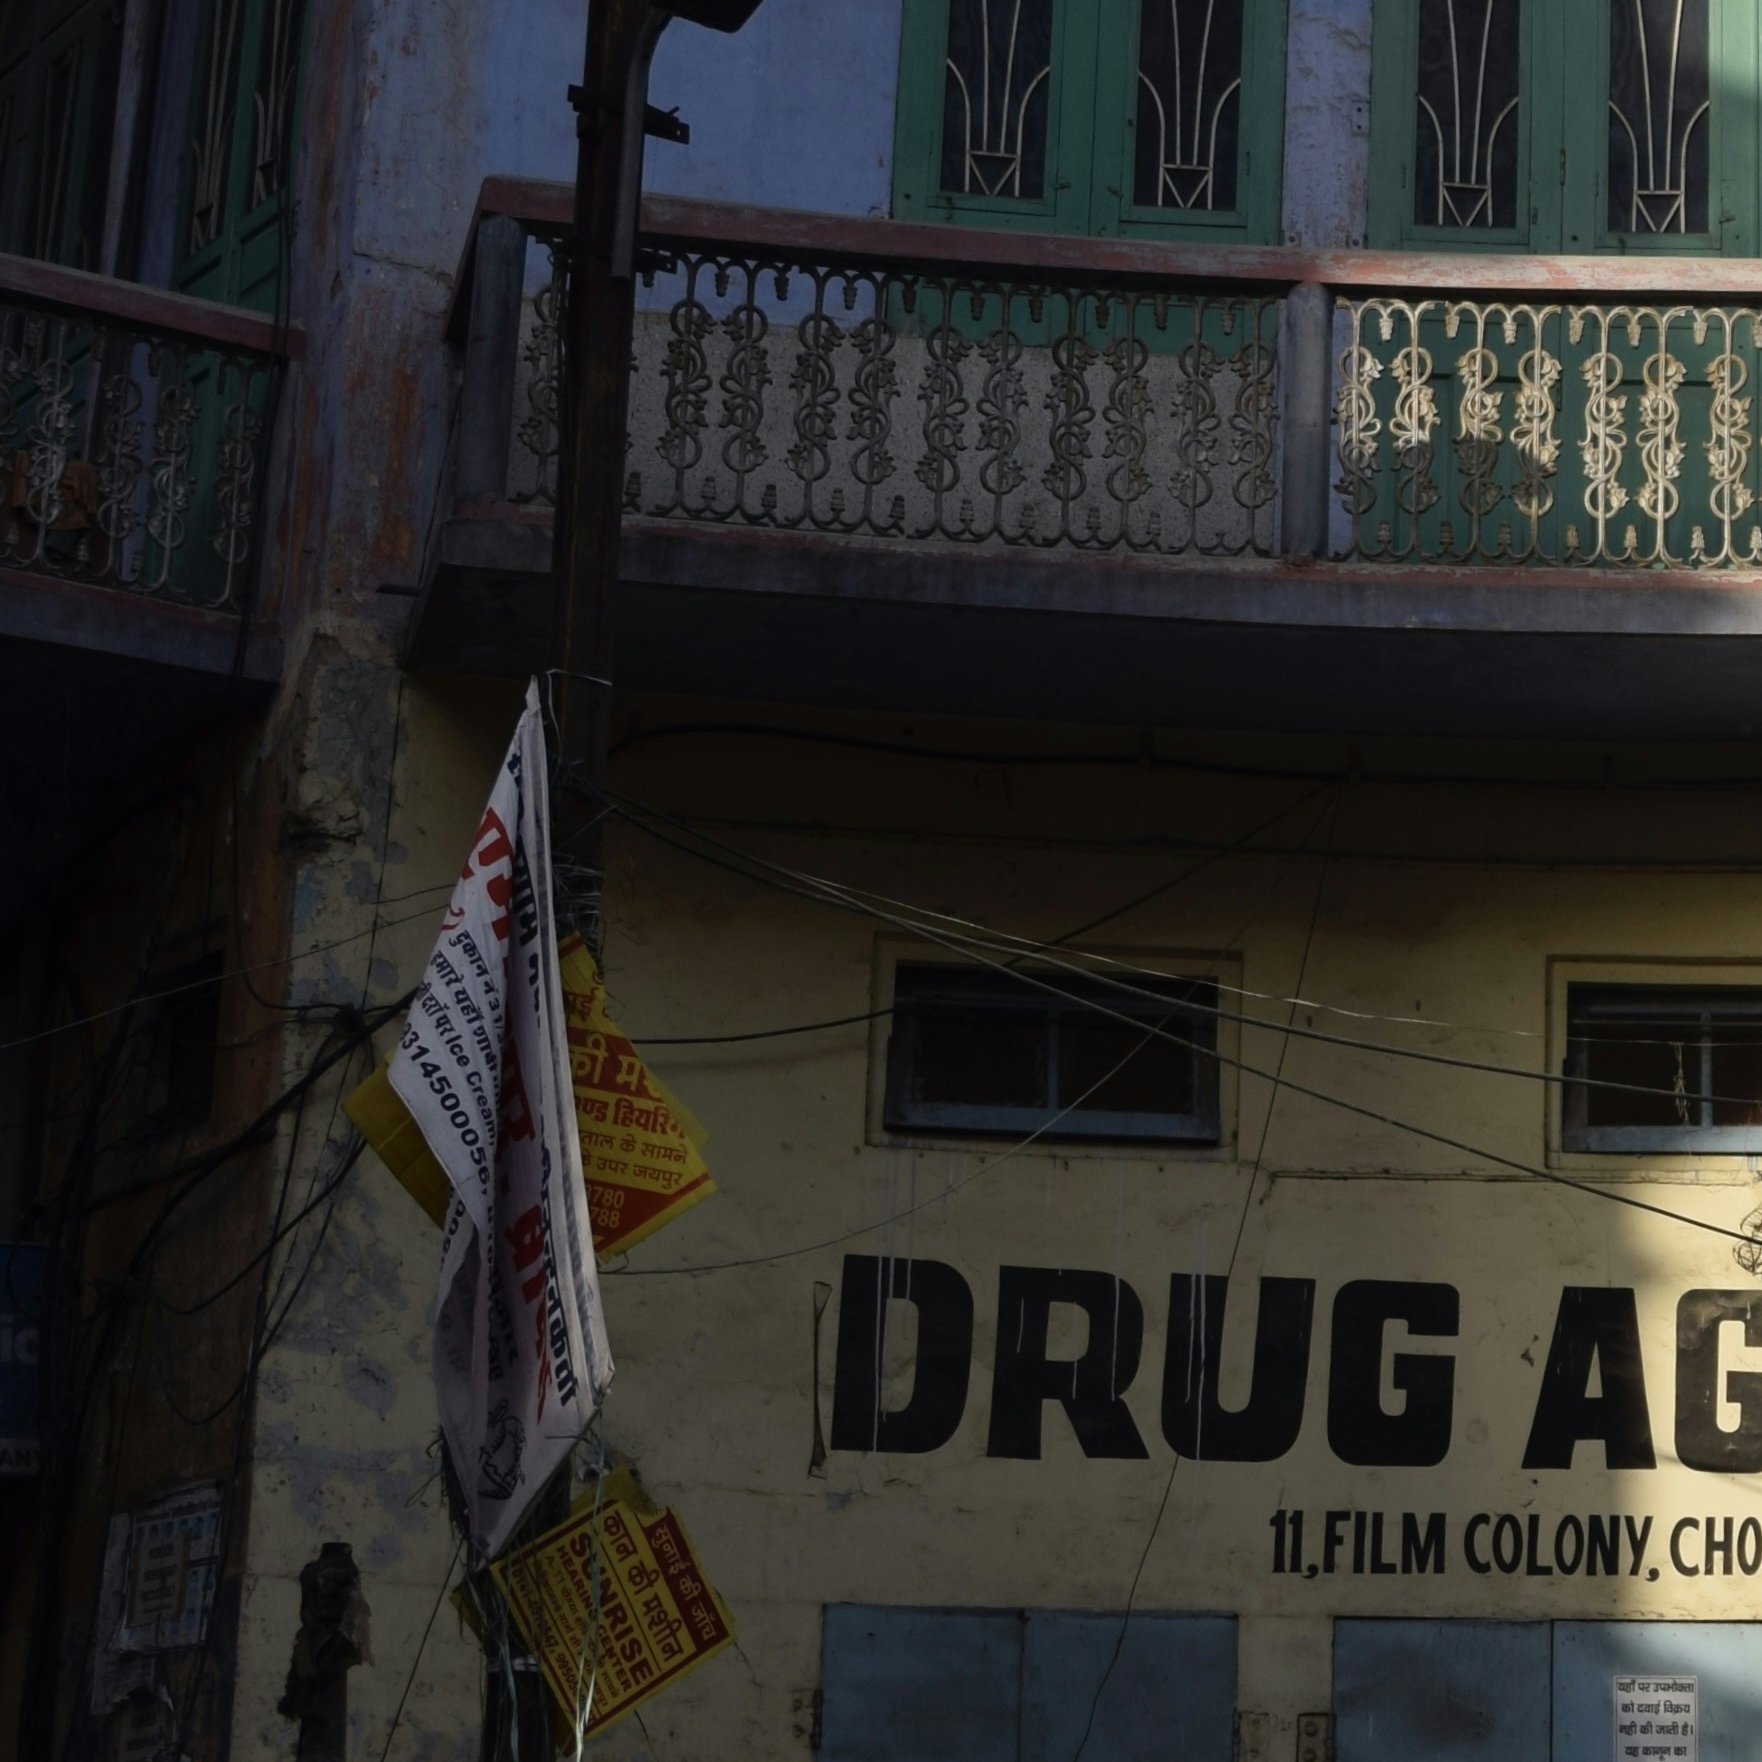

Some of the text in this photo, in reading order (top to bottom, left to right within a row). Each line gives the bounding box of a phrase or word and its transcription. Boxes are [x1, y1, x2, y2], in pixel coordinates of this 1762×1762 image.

[445, 1032, 470, 1072] Ice
[620, 1133, 688, 1165] के सामने
[595, 1156, 683, 1189] उपर जयपुर
[830, 1253, 1460, 1467] DRUG
[652, 1523, 692, 1575] सुनाई
[679, 1578, 702, 1602] की
[604, 1510, 684, 1661] कान की मशीन
[570, 1533, 654, 1686] SUNRISE
[597, 1624, 633, 1692] CENTER
[1638, 1683, 1650, 1693] पर
[1622, 1701, 1634, 1714] को
[1637, 1701, 1661, 1714] दवाई
[1640, 1721, 1652, 1735] की
[1656, 1722, 1679, 1735] जाती
[1626, 1746, 1687, 1762] यह कानून का
